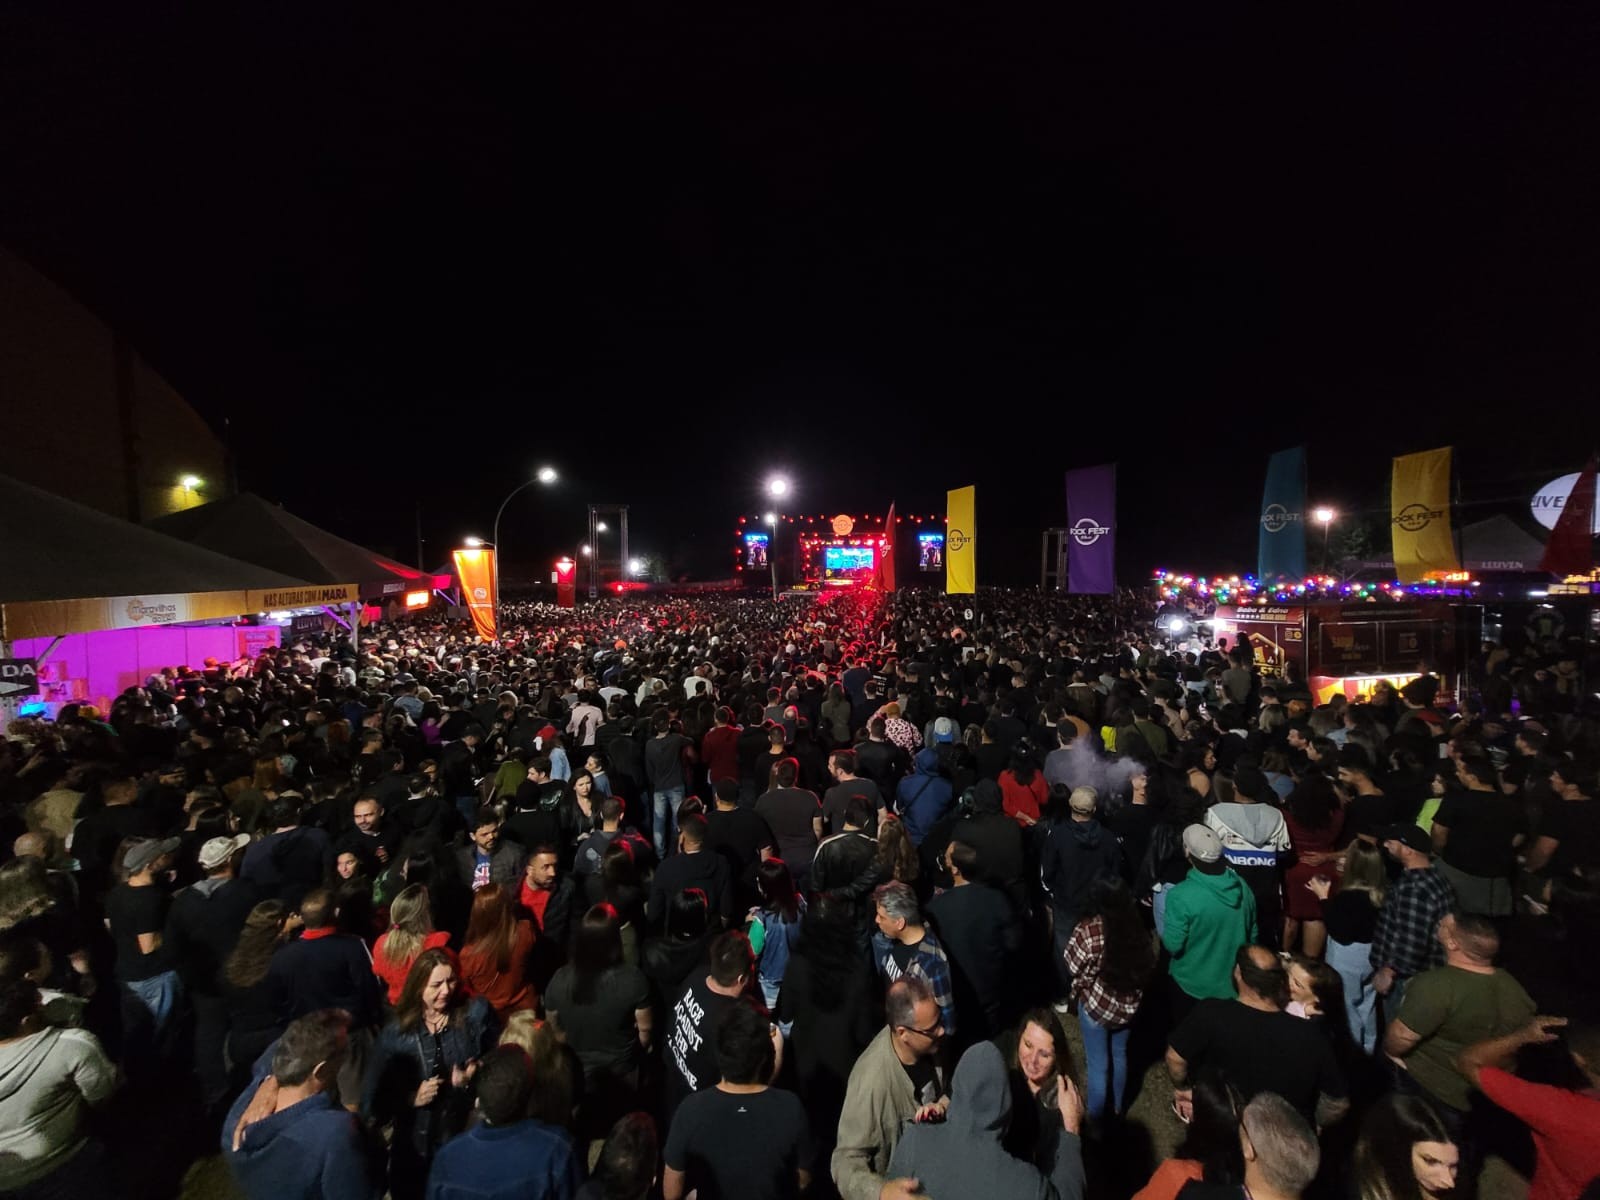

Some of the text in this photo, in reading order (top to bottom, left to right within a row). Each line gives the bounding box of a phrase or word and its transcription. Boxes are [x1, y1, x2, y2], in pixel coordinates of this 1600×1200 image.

[1276, 512, 1300, 521] FEST
[1392, 510, 1444, 523] OCK FEST
[1088, 527, 1110, 535] FEST
[263, 592, 277, 608] NAS
[278, 590, 304, 606] ALTURAS
[322, 587, 348, 601] MARA
[2, 664, 36, 677] DA
[684, 987, 705, 1026] RAGE
[674, 1000, 703, 1052] AGAINST
